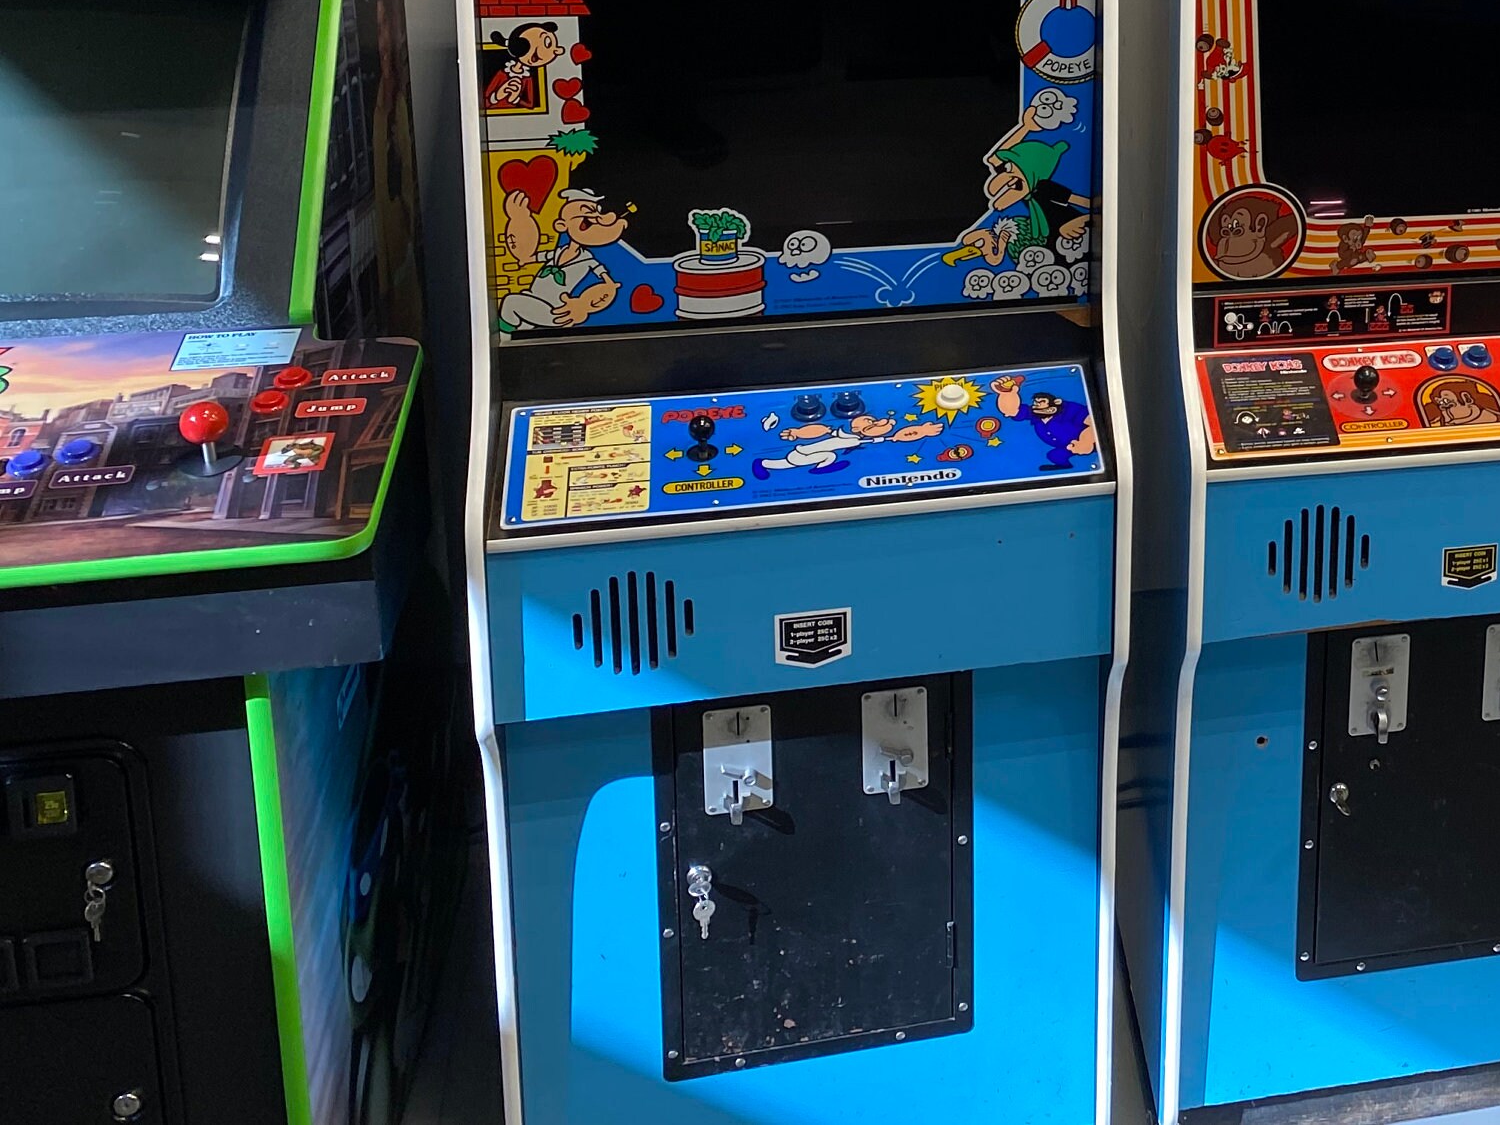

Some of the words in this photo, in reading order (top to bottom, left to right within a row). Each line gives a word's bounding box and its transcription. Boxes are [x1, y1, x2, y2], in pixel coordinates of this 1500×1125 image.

[1042, 59, 1092, 74] POPEYE
[1222, 362, 1267, 373] DONKEY
[1269, 359, 1302, 371] KONG
[1328, 356, 1376, 368] DONKEY
[1381, 353, 1417, 365] KONG
[328, 371, 390, 382] Attack
[305, 403, 357, 414] Jump
[1343, 421, 1404, 431] CONTROLLER
[57, 470, 127, 483] Attack
[866, 469, 957, 488] Nintendo
[674, 478, 735, 493] CONTROLLER
[793, 621, 815, 629] INSERT
